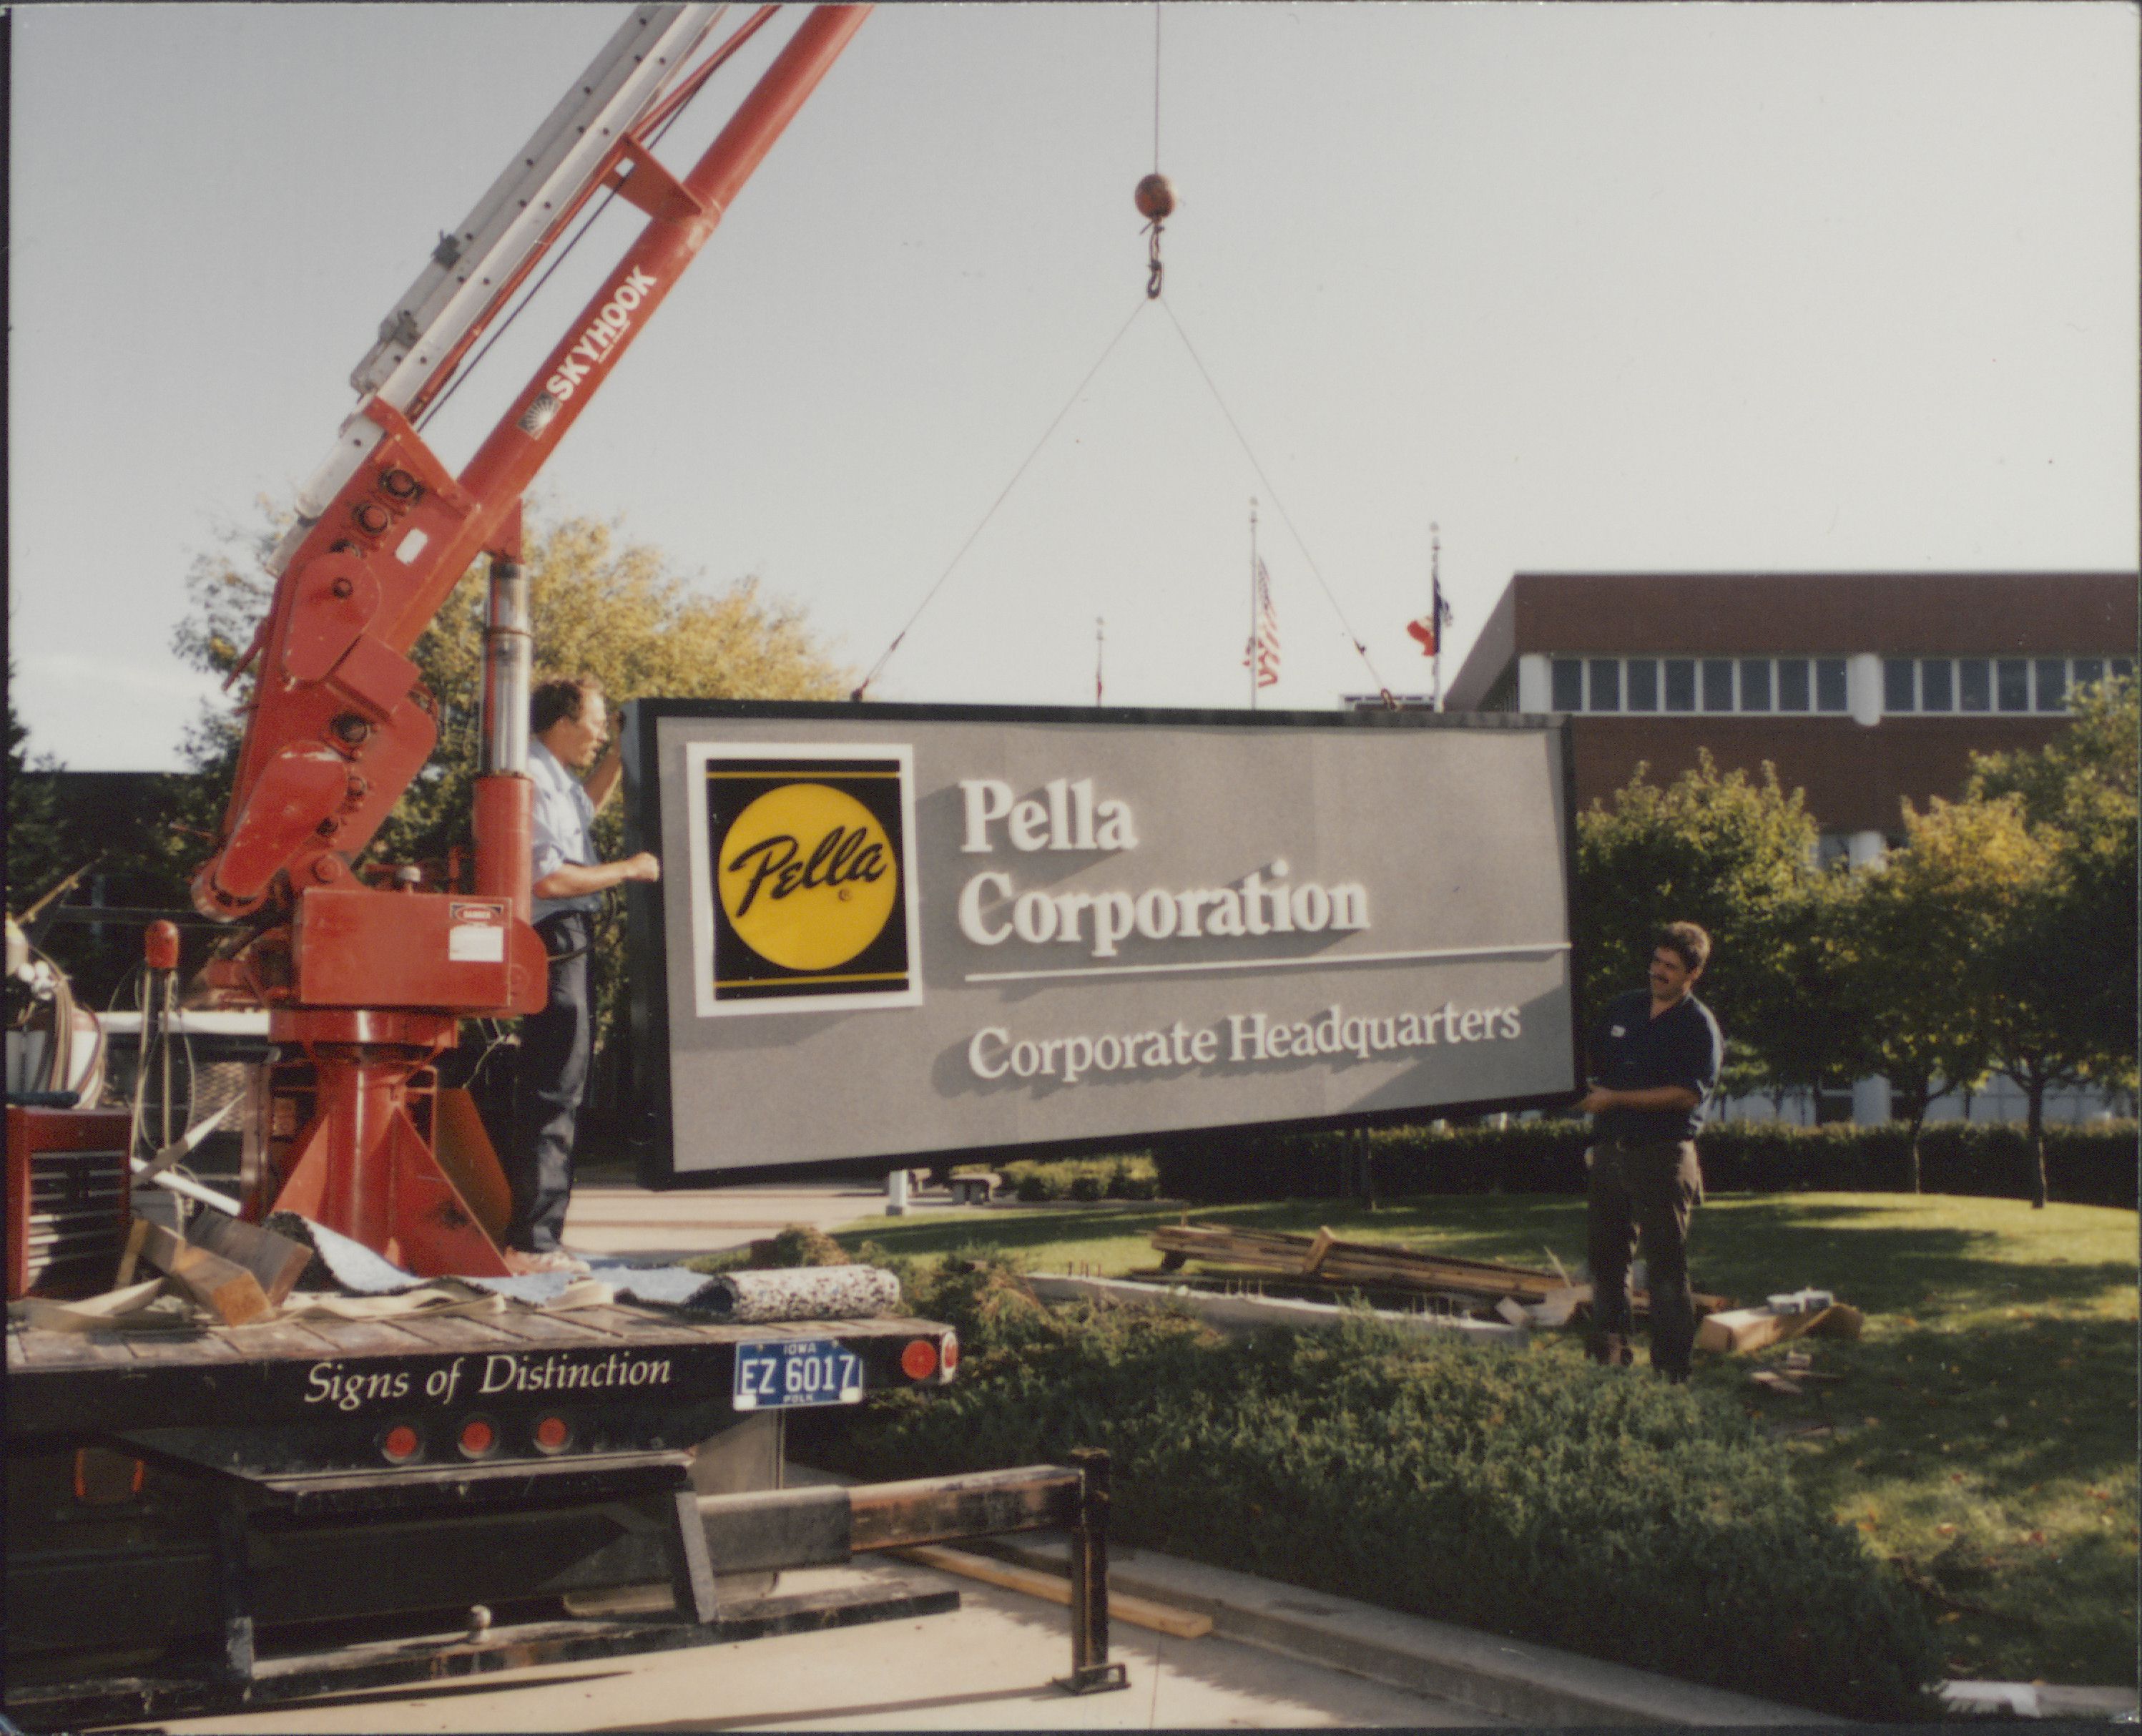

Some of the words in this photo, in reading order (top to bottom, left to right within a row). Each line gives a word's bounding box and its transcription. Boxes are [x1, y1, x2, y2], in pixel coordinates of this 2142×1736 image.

[546, 264, 657, 401] SKYHOOK
[959, 777, 1138, 853] Pella
[728, 825, 888, 918] Pella
[958, 858, 1371, 957] Corporation
[968, 1019, 1218, 1082] Corporate
[1228, 1001, 1521, 1061] Headquarters
[304, 1361, 410, 1411] Signs
[426, 1358, 465, 1405] of
[478, 1350, 672, 1394] Distinction
[741, 1358, 776, 1394] EZ
[786, 1355, 855, 1393] 6017
[784, 1343, 816, 1355] IOWA
